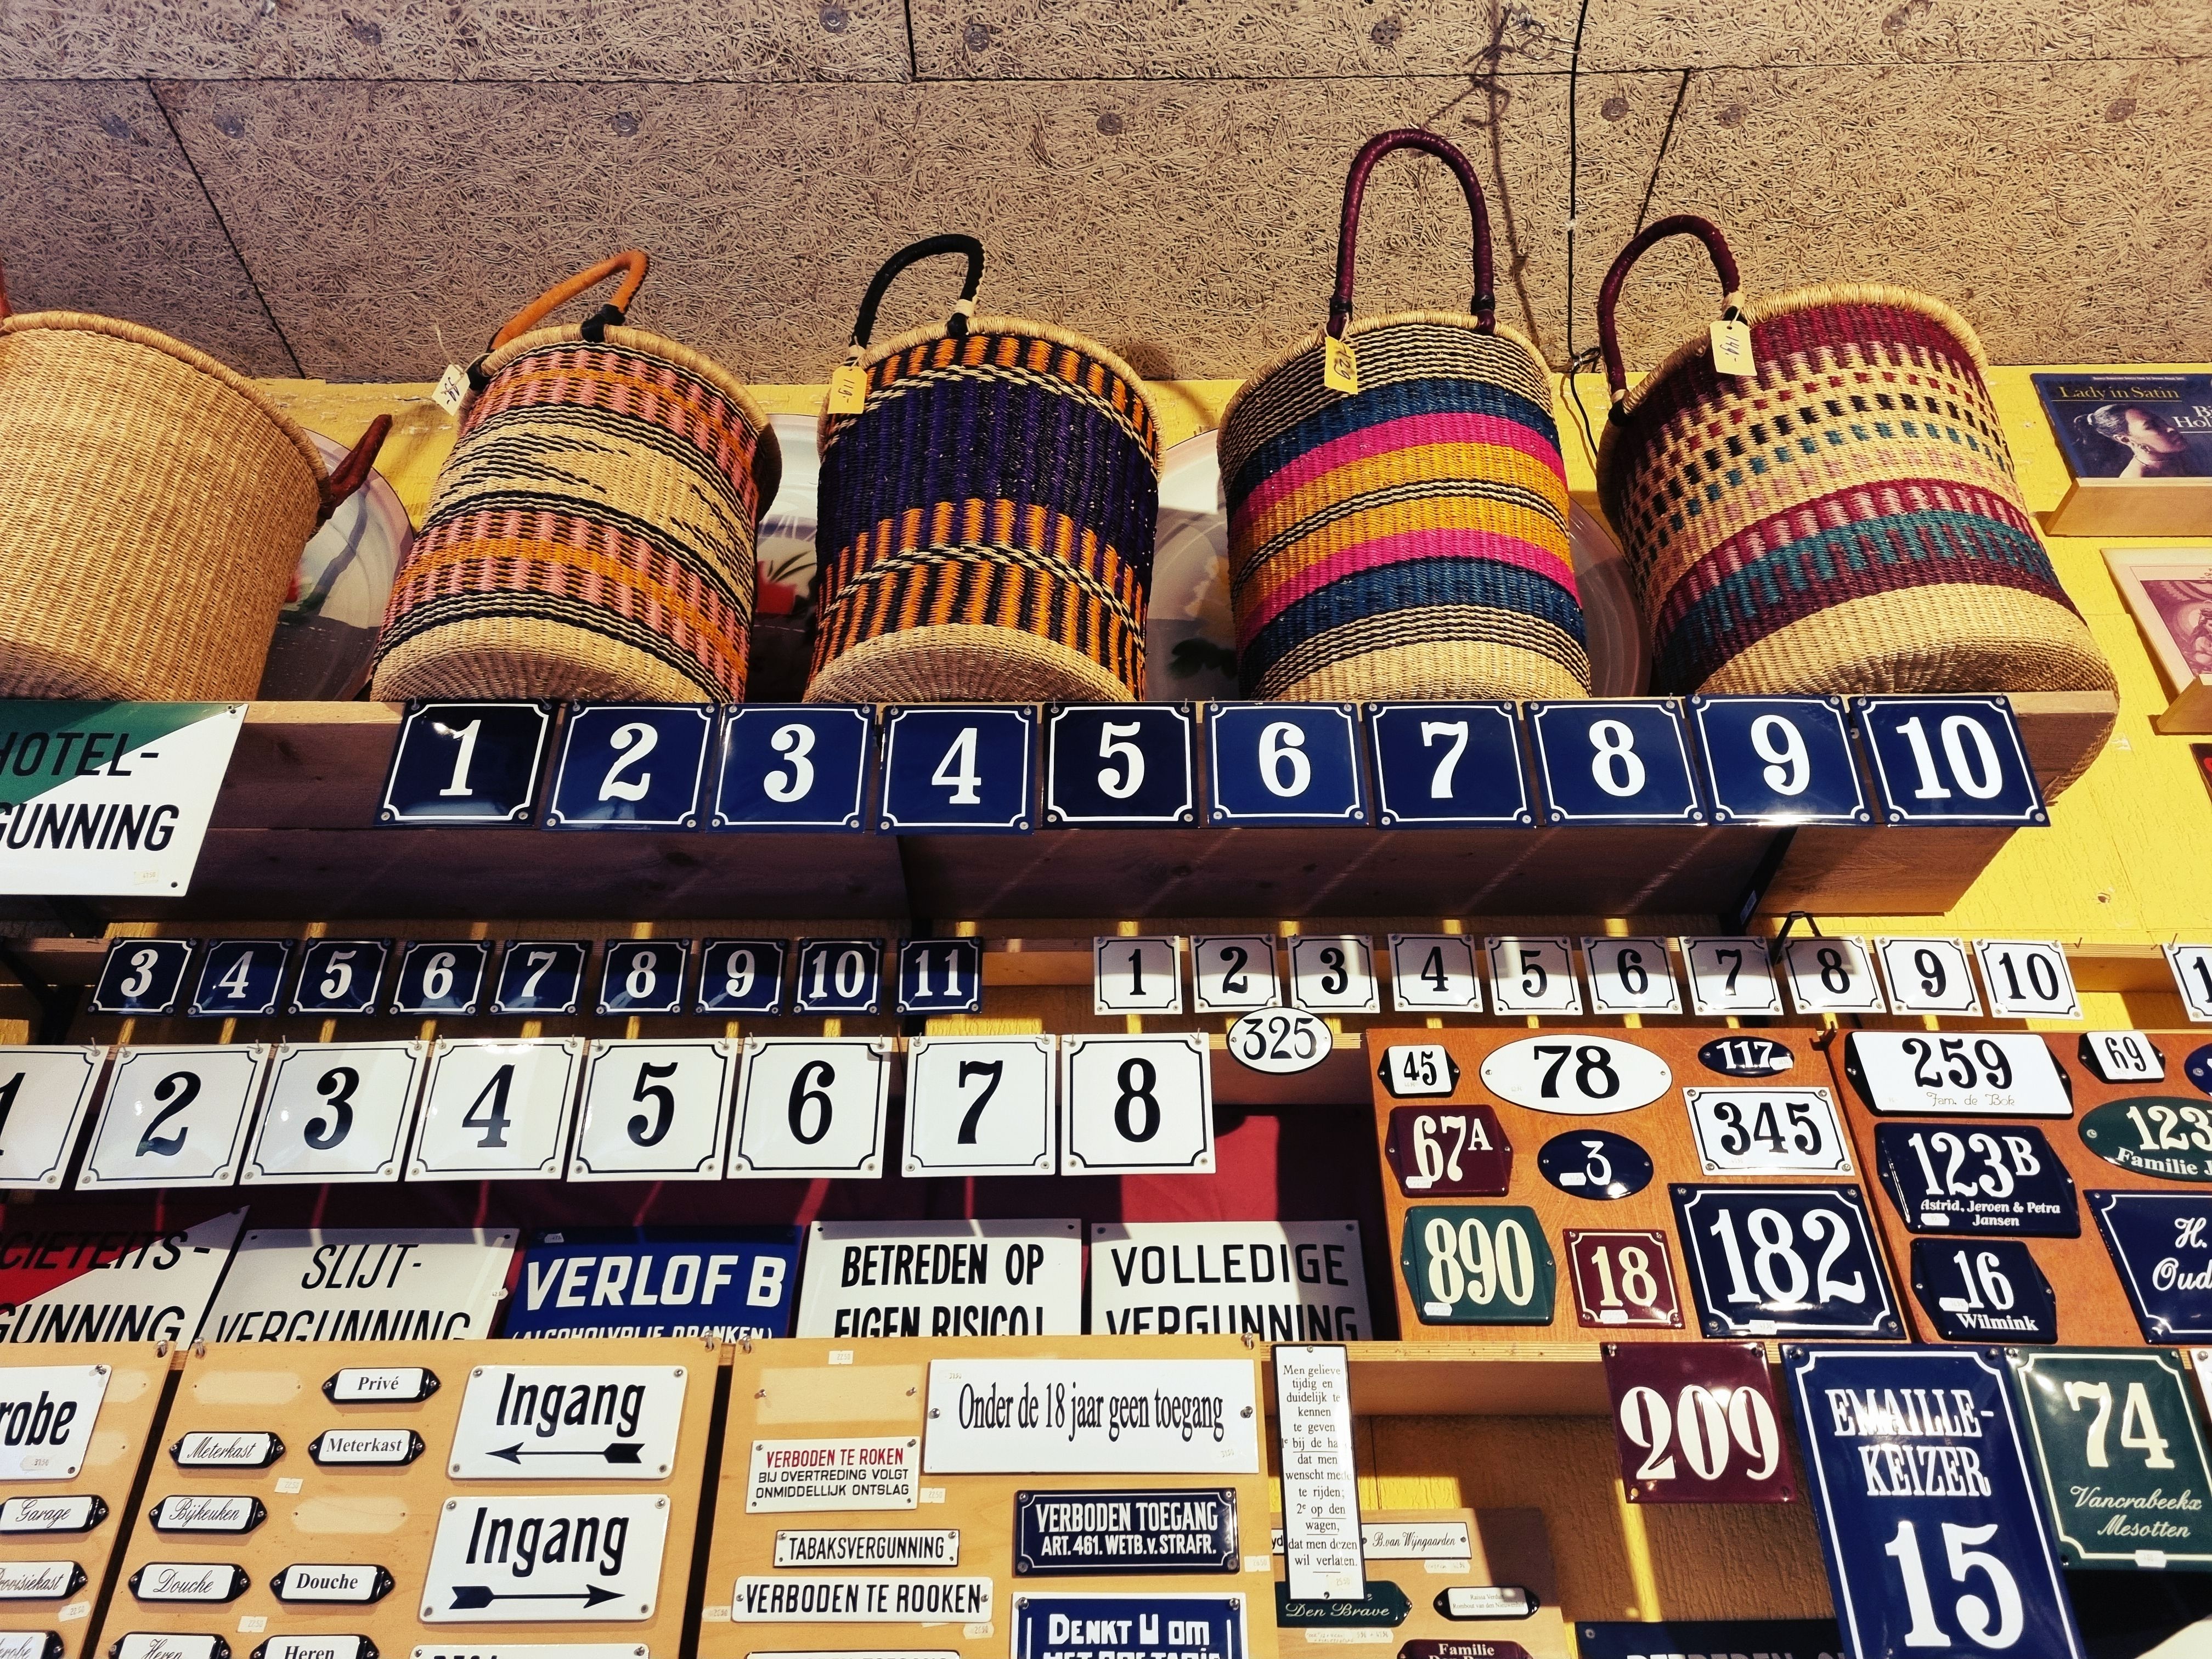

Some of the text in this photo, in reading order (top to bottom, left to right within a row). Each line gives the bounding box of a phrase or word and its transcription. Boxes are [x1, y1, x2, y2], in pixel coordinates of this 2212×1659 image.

[2059, 386, 2180, 400] Lady in Satin
[439, 719, 481, 795] 1
[599, 722, 658, 801] 2
[763, 724, 816, 802] 3
[931, 727, 981, 804] 4
[1097, 721, 1145, 798] 5
[1259, 721, 1311, 797] 6
[1421, 721, 1469, 799] 7
[1588, 719, 1646, 797] 8
[1751, 714, 1810, 796] 9
[1896, 715, 2003, 799] 10
[121, 949, 159, 997] 3
[219, 951, 255, 998] 4
[320, 950, 357, 999] 5
[423, 952, 456, 1000] 6
[522, 951, 557, 997] 7
[625, 951, 657, 998] 8
[726, 949, 755, 997] 9
[809, 949, 866, 998] 10
[914, 949, 963, 997] 11
[1128, 949, 1147, 996] 1
[1220, 946, 1249, 994] 2
[1319, 946, 1348, 995] 3
[1420, 946, 1449, 992] 4
[1519, 949, 1548, 998] 5
[1616, 948, 1648, 995] 6
[1716, 949, 1743, 996] 7
[1818, 947, 1851, 994] 8
[1913, 949, 1947, 997] 9
[1997, 951, 2060, 1001] 10
[1242, 1016, 1317, 1060] 325
[1716, 1040, 1773, 1069] 117
[2105, 1036, 2147, 1072] 69
[1402, 1051, 1437, 1085] 45
[1533, 1045, 1620, 1099] 78
[1901, 1037, 2012, 1090] 259
[135, 1071, 202, 1157] 2
[304, 1066, 359, 1150] 3
[462, 1064, 515, 1148] 4
[627, 1061, 678, 1147] 5
[788, 1059, 836, 1145] 6
[957, 1059, 1004, 1144] 7
[1114, 1057, 1161, 1143] 8
[1964, 1094, 1978, 1105] de
[1985, 1094, 2015, 1106] Bok
[1713, 1101, 1822, 1155] 345
[2126, 1105, 2212, 1152] 123
[1581, 1140, 1612, 1186] 3
[2117, 1146, 2198, 1175] Familie
[1967, 1200, 2010, 1212] Jeroen
[2013, 1201, 2024, 1213] &
[2027, 1202, 2061, 1214] Petra
[1972, 1214, 2020, 1226] Jansen
[2174, 1217, 2208, 1248] H.
[301, 1244, 422, 1289] SLIJT-
[841, 1243, 1045, 1288] BETREDEN OP
[1111, 1243, 1349, 1287] VOLLEDIGE
[1424, 1217, 1535, 1305] 890
[1591, 1245, 1656, 1307] 18
[1709, 1208, 1866, 1306] 182
[527, 1255, 787, 1311] VERLOF B
[1954, 1250, 2015, 1311] 16
[834, 1306, 921, 1338] EIGEN
[1105, 1304, 1357, 1341] VERGUNNING
[1956, 1313, 2039, 1331] Wilmink
[357, 1375, 399, 1391] Privé
[1283, 1364, 1341, 1378] Men gelieve
[1293, 1378, 1317, 1391] tijdig
[496, 1372, 646, 1437] Ingang
[959, 1381, 1224, 1442] Onder de 18 jaar geen toegang
[1286, 1392, 1340, 1404] duidelijk te
[1298, 1407, 1331, 1417] kennen
[326, 1437, 403, 1453] Meterkast
[1293, 1437, 1322, 1451] bij de
[1294, 1423, 1335, 1435] te geven
[1620, 1384, 1779, 1481] 209
[2063, 1381, 2176, 1468] 74
[187, 1437, 257, 1459] Meterkast
[766, 1448, 904, 1469] VERBODEN TE ROKEN
[1297, 1454, 1338, 1465] dat men
[755, 1483, 910, 1499] ONMIDDELLIJK ONTSLAG
[758, 1468, 909, 1483] BIJ OVERTREDING VOLGT
[1285, 1469, 1324, 1480] wenscht
[1299, 1488, 1307, 1497] te
[1858, 1446, 1992, 1497] KEIZER
[16, 1499, 72, 1527] Garage
[170, 1498, 240, 1523] Bijkeuken
[1035, 1502, 1218, 1532] VERBODEN TOEGANG
[1306, 1521, 1340, 1533] wagen,
[1311, 1503, 1346, 1517] op den
[2097, 1514, 2191, 1538] Mesotten
[465, 1506, 630, 1577] Ingang
[789, 1536, 944, 1560] TABAKSVERGUNNING
[1289, 1538, 1303, 1549] dat
[1306, 1541, 1327, 1549] men
[1295, 1555, 1310, 1565] wil
[1402, 1532, 1455, 1551] Wijngaarden
[153, 1568, 215, 1593] Douche
[296, 1572, 358, 1590] Douche
[747, 1583, 981, 1613] VERBODEN TE ROOKEN
[1884, 1520, 2024, 1649] 15
[1139, 1613, 1159, 1645] U
[1285, 1603, 1390, 1617] Den Brave
[1437, 1643, 1495, 1656] Familie
